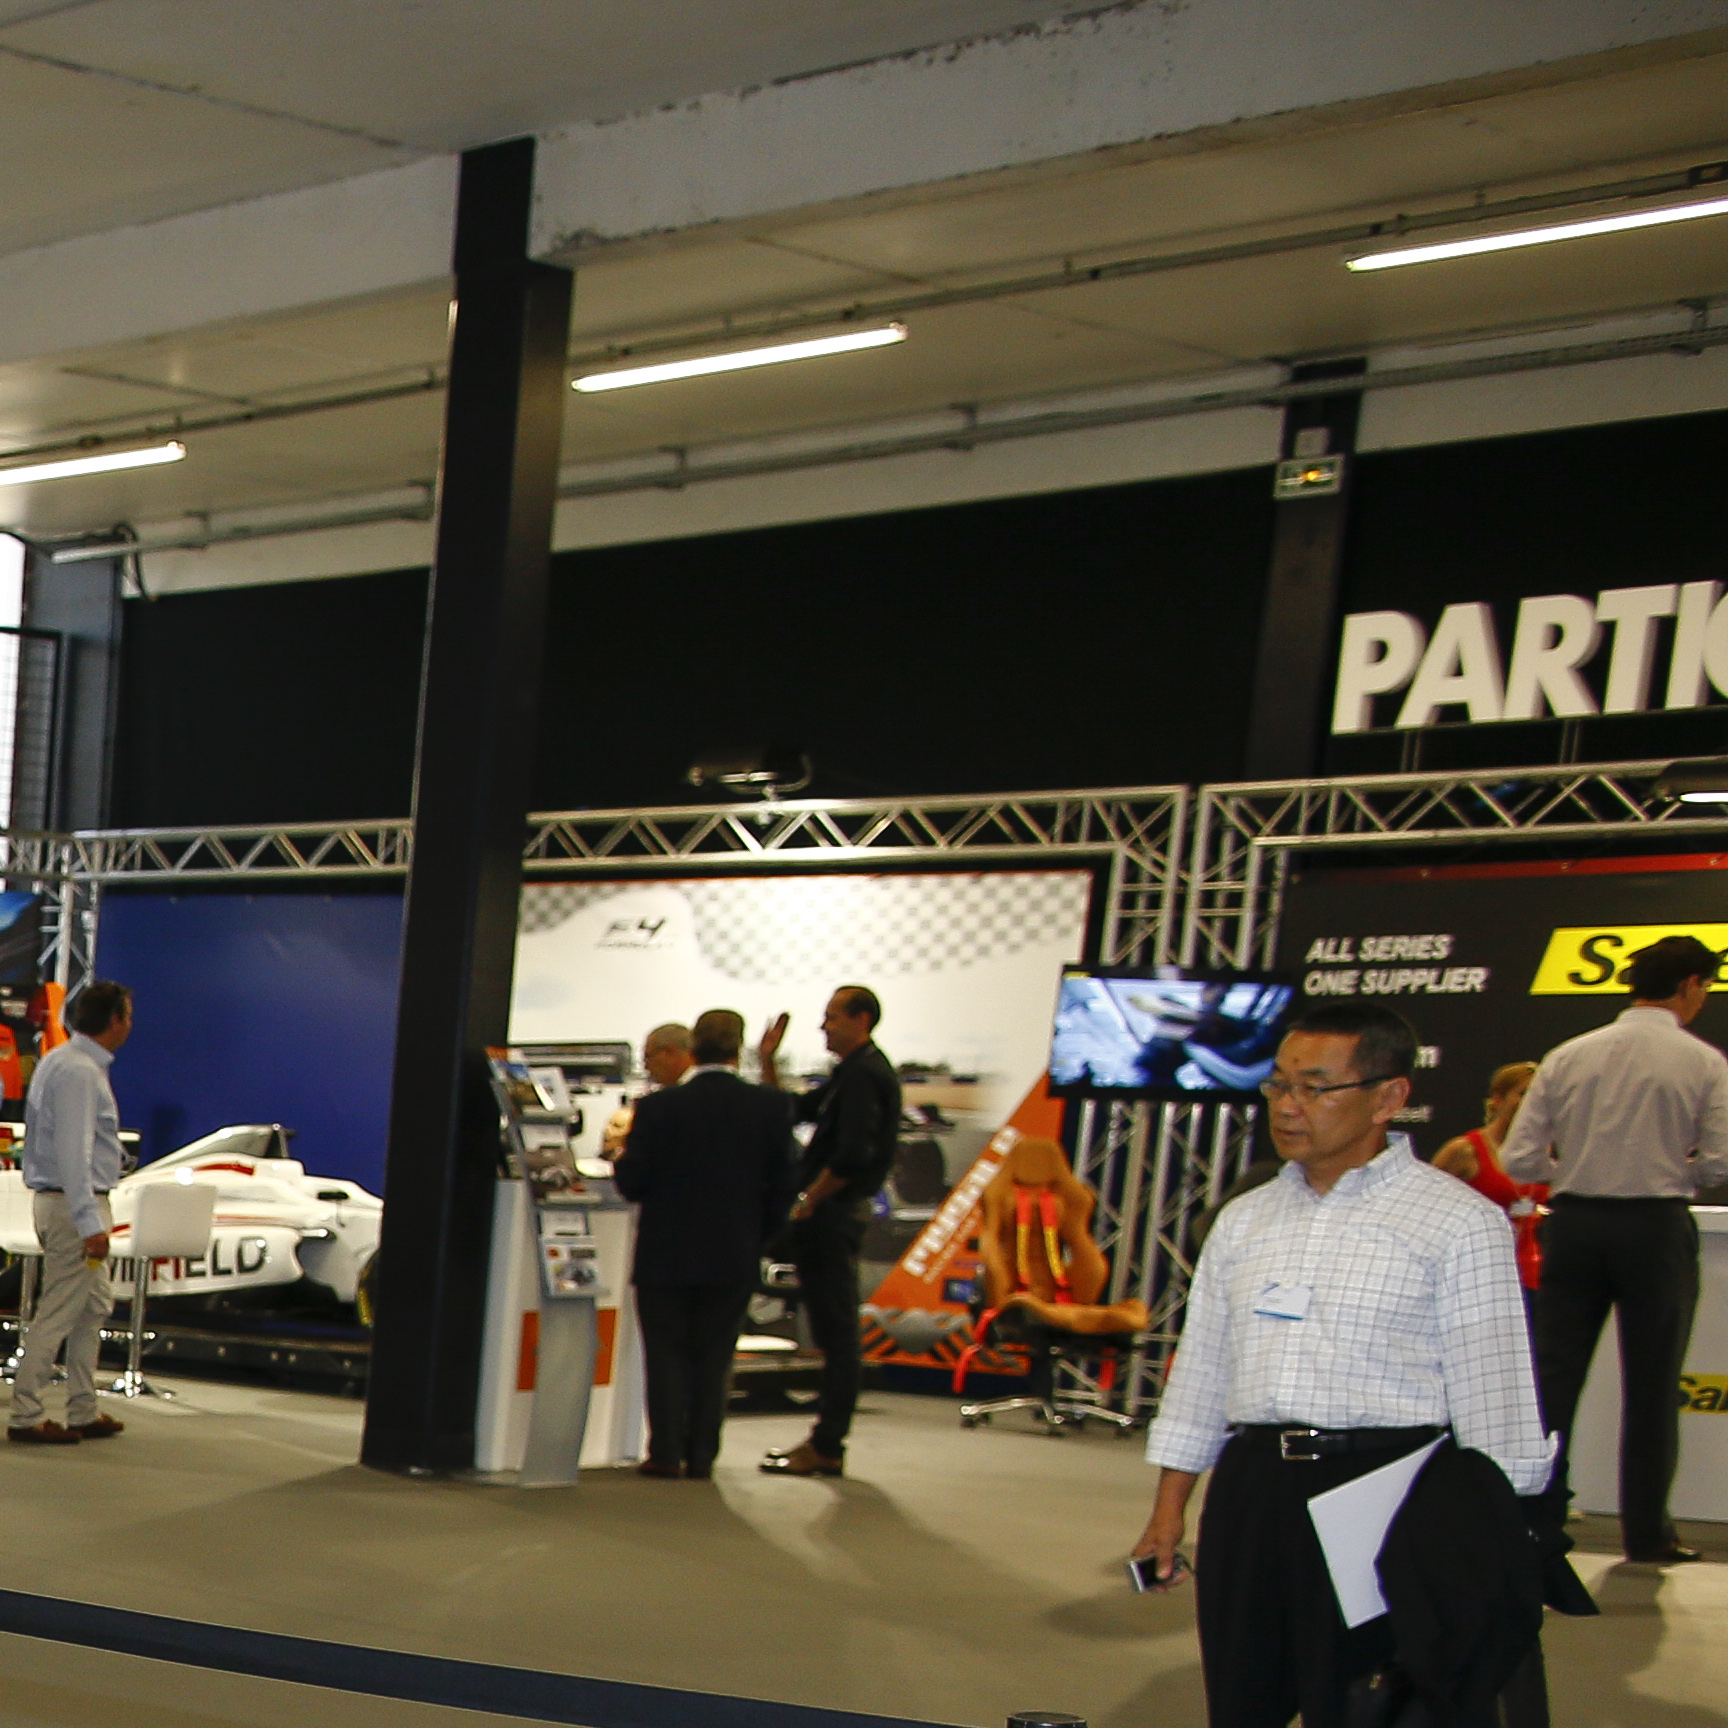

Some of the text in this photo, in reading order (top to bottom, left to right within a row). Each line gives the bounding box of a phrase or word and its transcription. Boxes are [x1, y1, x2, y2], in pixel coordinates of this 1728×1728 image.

[1332, 579, 1728, 735] PARTI
[1305, 934, 1456, 963] ALL SERIES
[1303, 966, 1491, 995] ONE SUPPLIER
